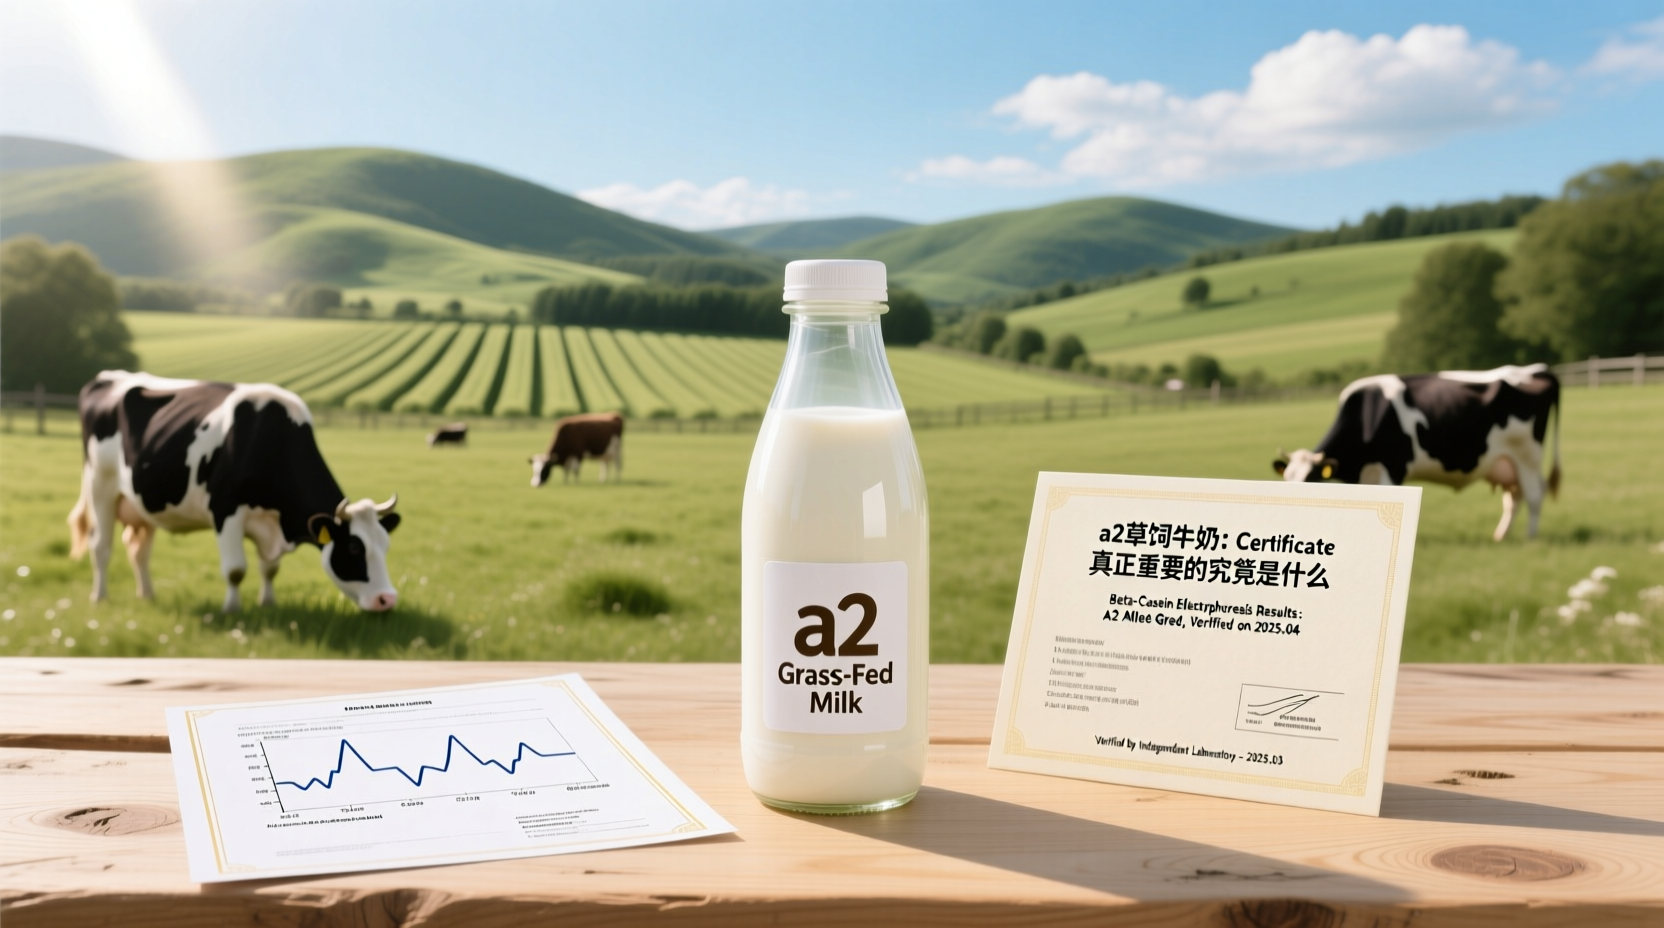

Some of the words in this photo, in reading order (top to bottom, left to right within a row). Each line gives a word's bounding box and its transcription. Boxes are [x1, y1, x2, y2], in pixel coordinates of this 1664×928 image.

[1236, 530, 1336, 557] Certificate
[1109, 592, 1174, 610] Beta-Casein
[1255, 604, 1304, 620] Results:
[793, 592, 880, 657] a2
[1102, 608, 1120, 623] A2
[1237, 621, 1252, 633] on
[1253, 620, 1302, 637] 2025.04
[778, 660, 894, 687] Grass-Fed
[810, 690, 864, 715] Milk
[1246, 750, 1285, 767] 2025.03
